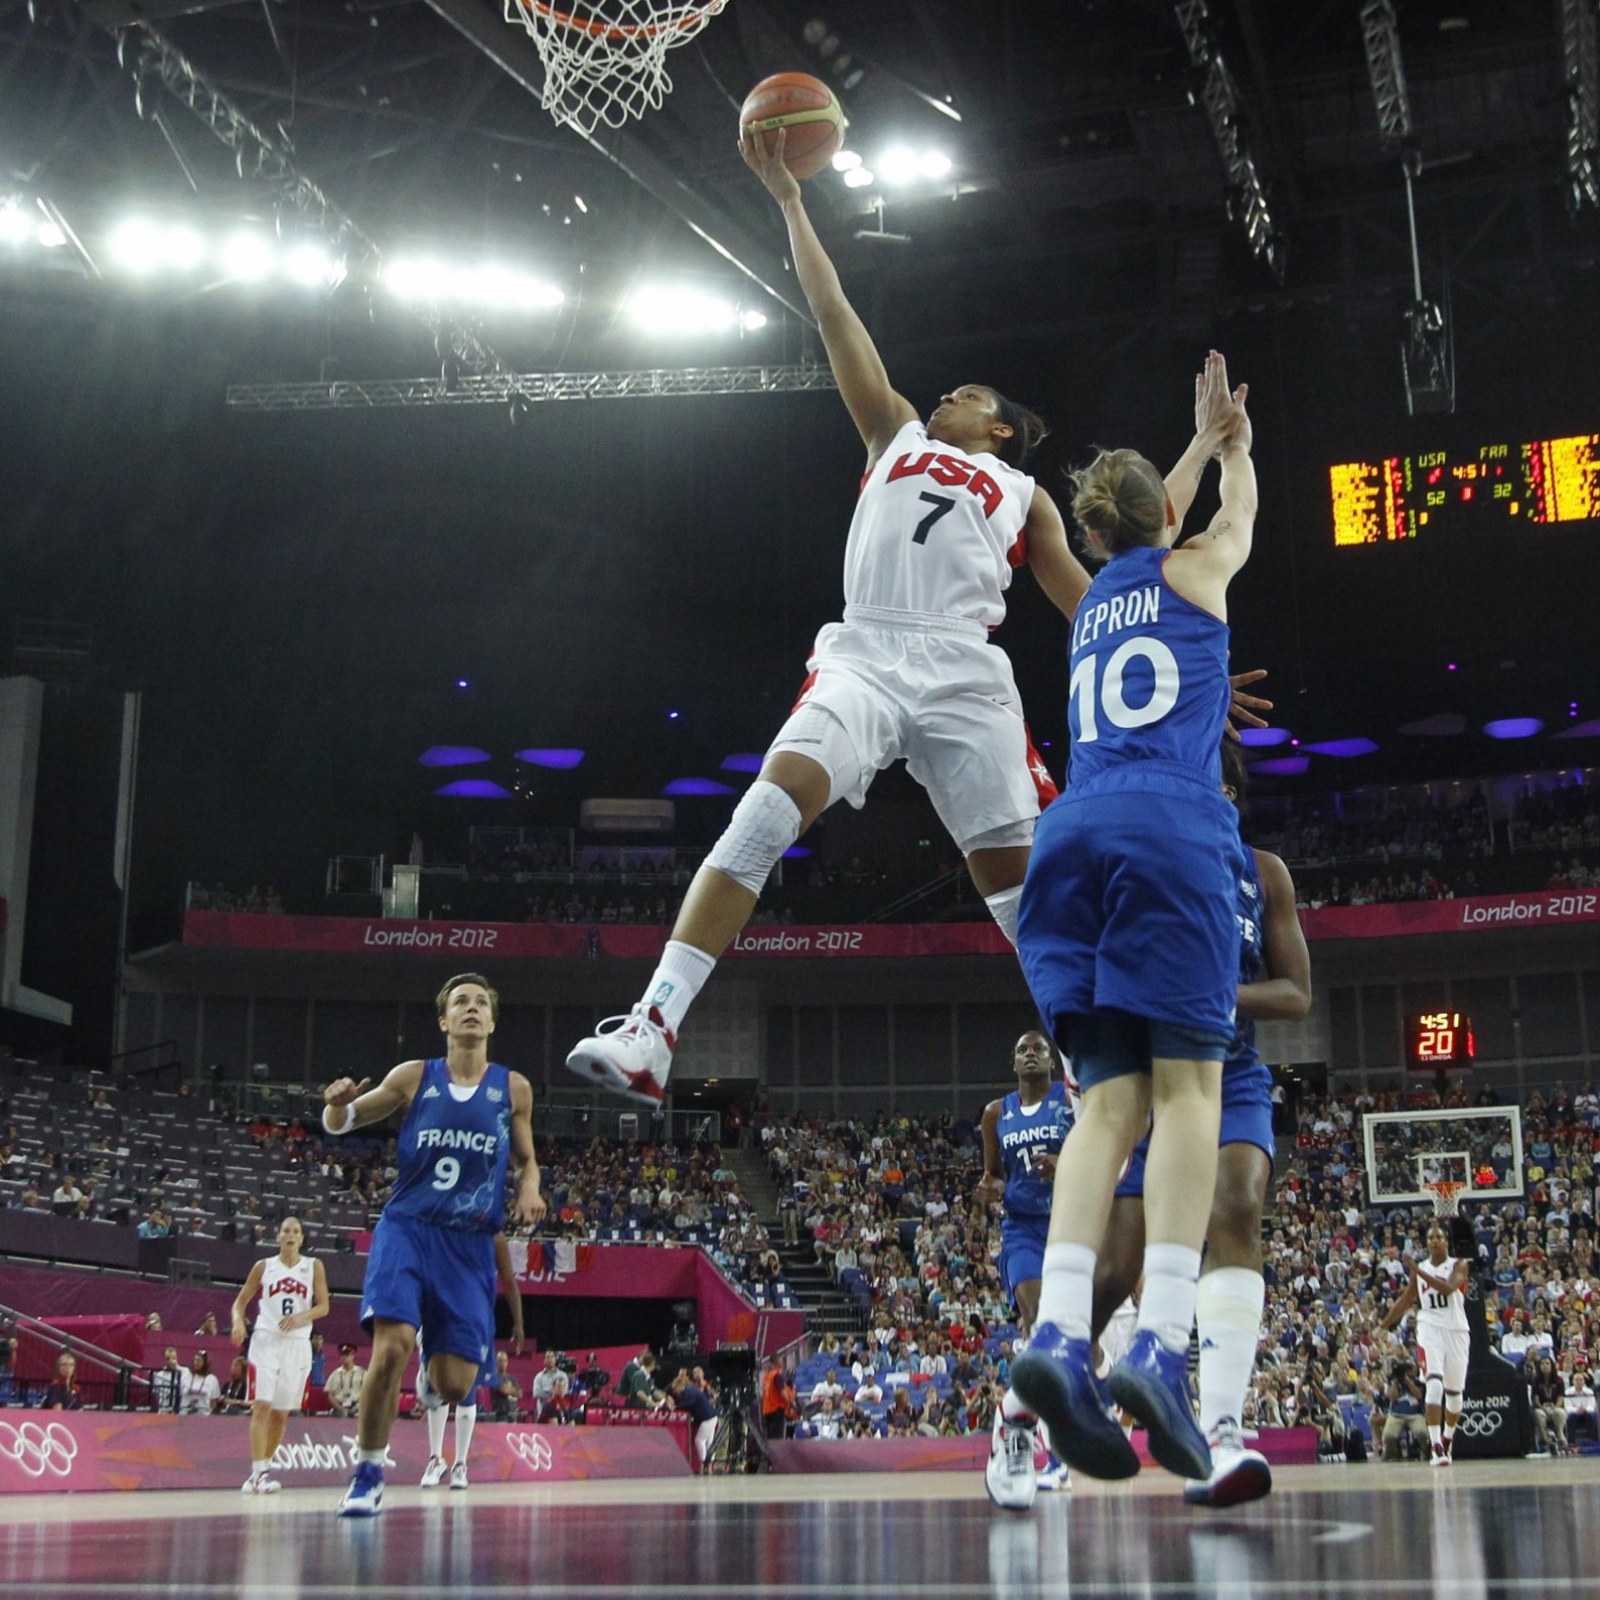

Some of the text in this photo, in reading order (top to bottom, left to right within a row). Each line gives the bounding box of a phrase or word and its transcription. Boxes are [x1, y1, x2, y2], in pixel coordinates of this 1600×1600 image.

[1419, 452, 1446, 468] USA
[1480, 444, 1508, 460] FRA
[1453, 464, 1487, 480] 4:51
[886, 452, 1004, 520] USA
[1493, 483, 1512, 498] 32
[1427, 490, 1446, 506] 52
[912, 491, 956, 545] 7
[1072, 585, 1160, 656] LEPRON
[1069, 636, 1180, 742] 10
[1463, 895, 1597, 923] London 2012
[364, 925, 498, 948] London 2012
[734, 931, 863, 950] London 2012
[1420, 1013, 1459, 1029] 4:51
[1419, 1031, 1453, 1055] 20
[417, 1128, 497, 1155] FRANCE
[1003, 1125, 1059, 1149] FRANCE
[432, 1156, 460, 1191] 9
[269, 1277, 308, 1299] USA
[282, 1298, 294, 1316] 6
[1429, 1292, 1448, 1309] 10
[1486, 1395, 1511, 1408] 2012
